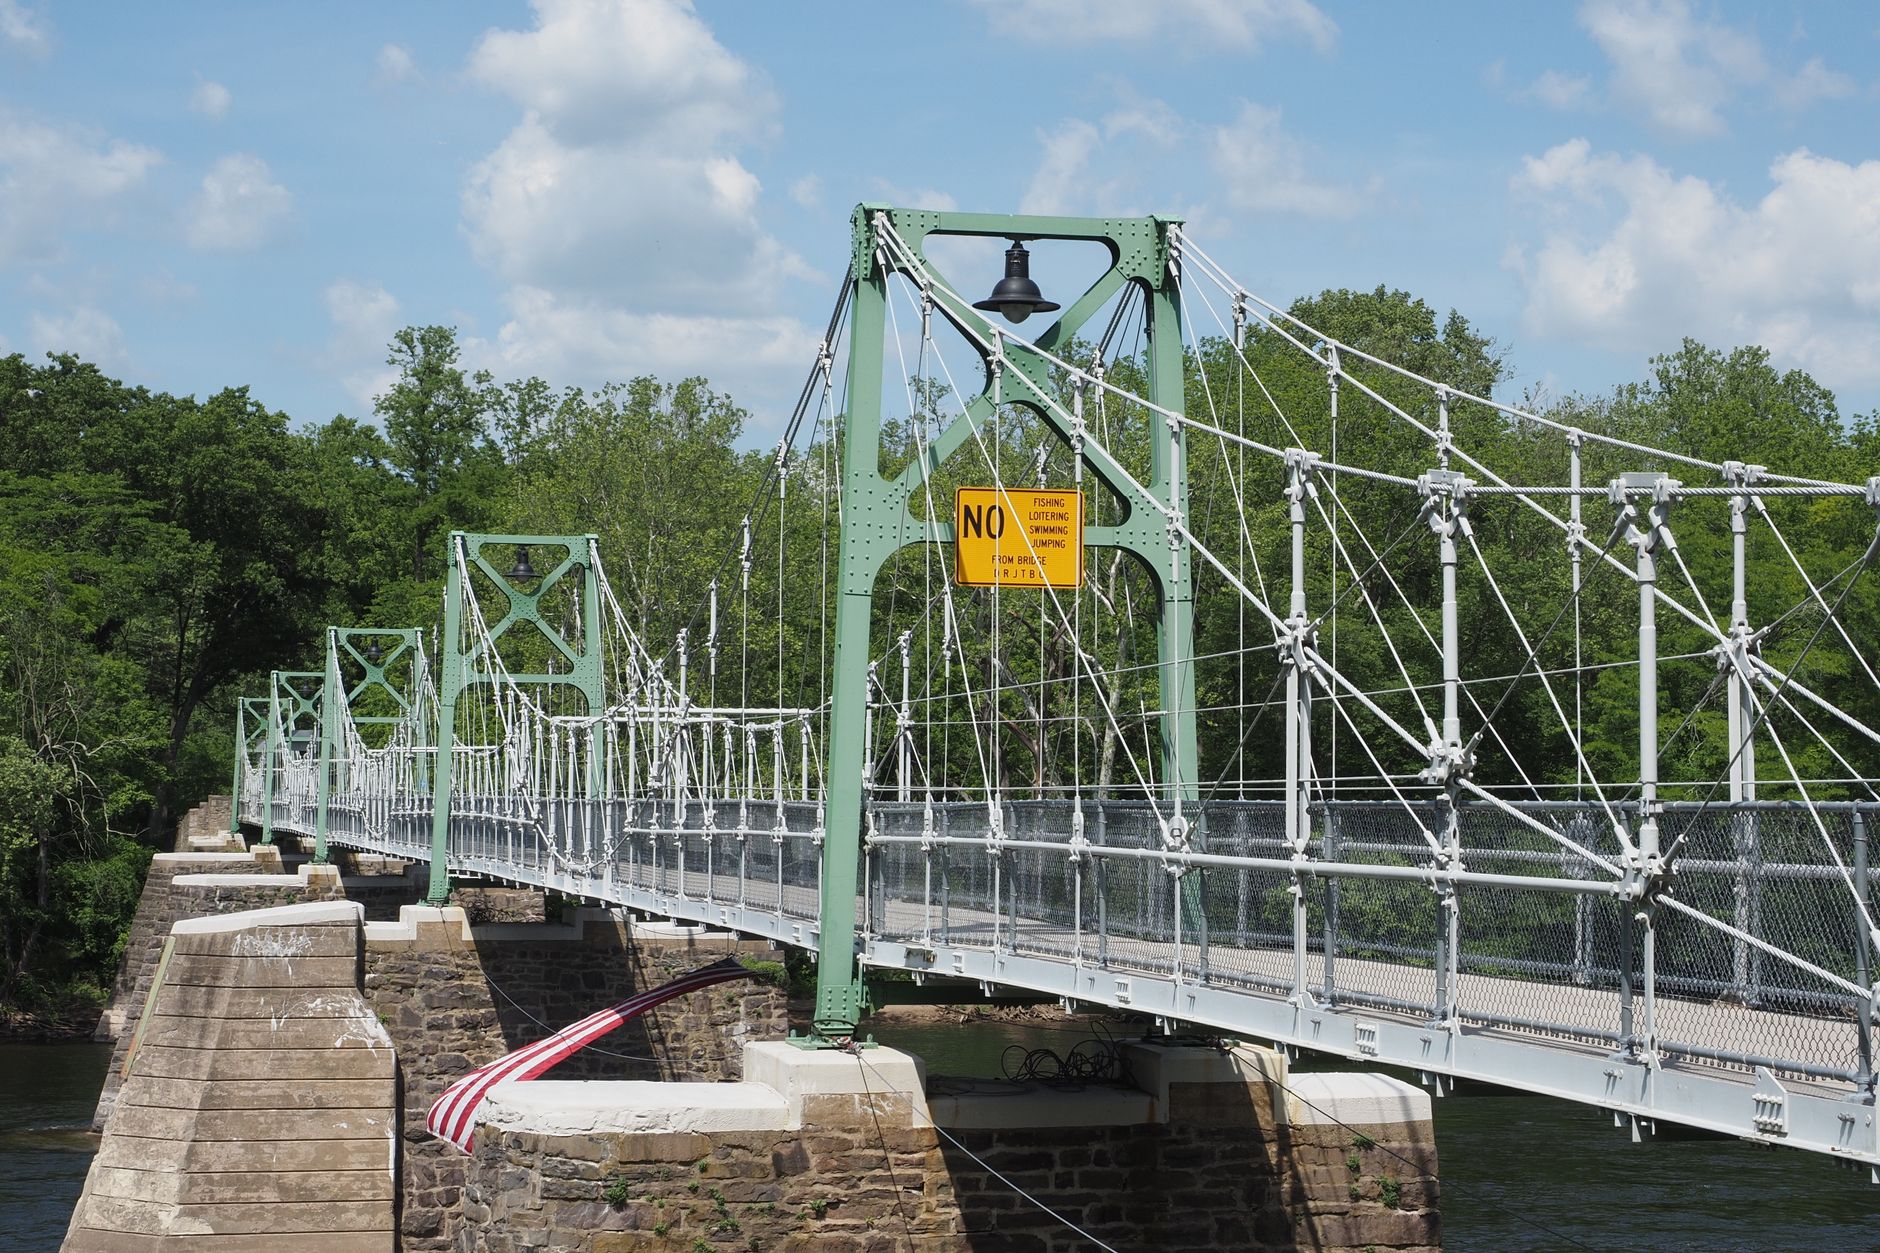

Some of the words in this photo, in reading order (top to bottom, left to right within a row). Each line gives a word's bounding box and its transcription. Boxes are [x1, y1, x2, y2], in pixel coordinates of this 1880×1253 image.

[1033, 498, 1065, 507] FISHING
[1029, 511, 1069, 521] LOITERING
[963, 504, 1005, 539] NO
[1029, 525, 1068, 535] SWIMMING
[1031, 539, 1066, 549] JUMPING
[992, 555, 1014, 565] FROM
[1017, 556, 1047, 566] BRIDGE
